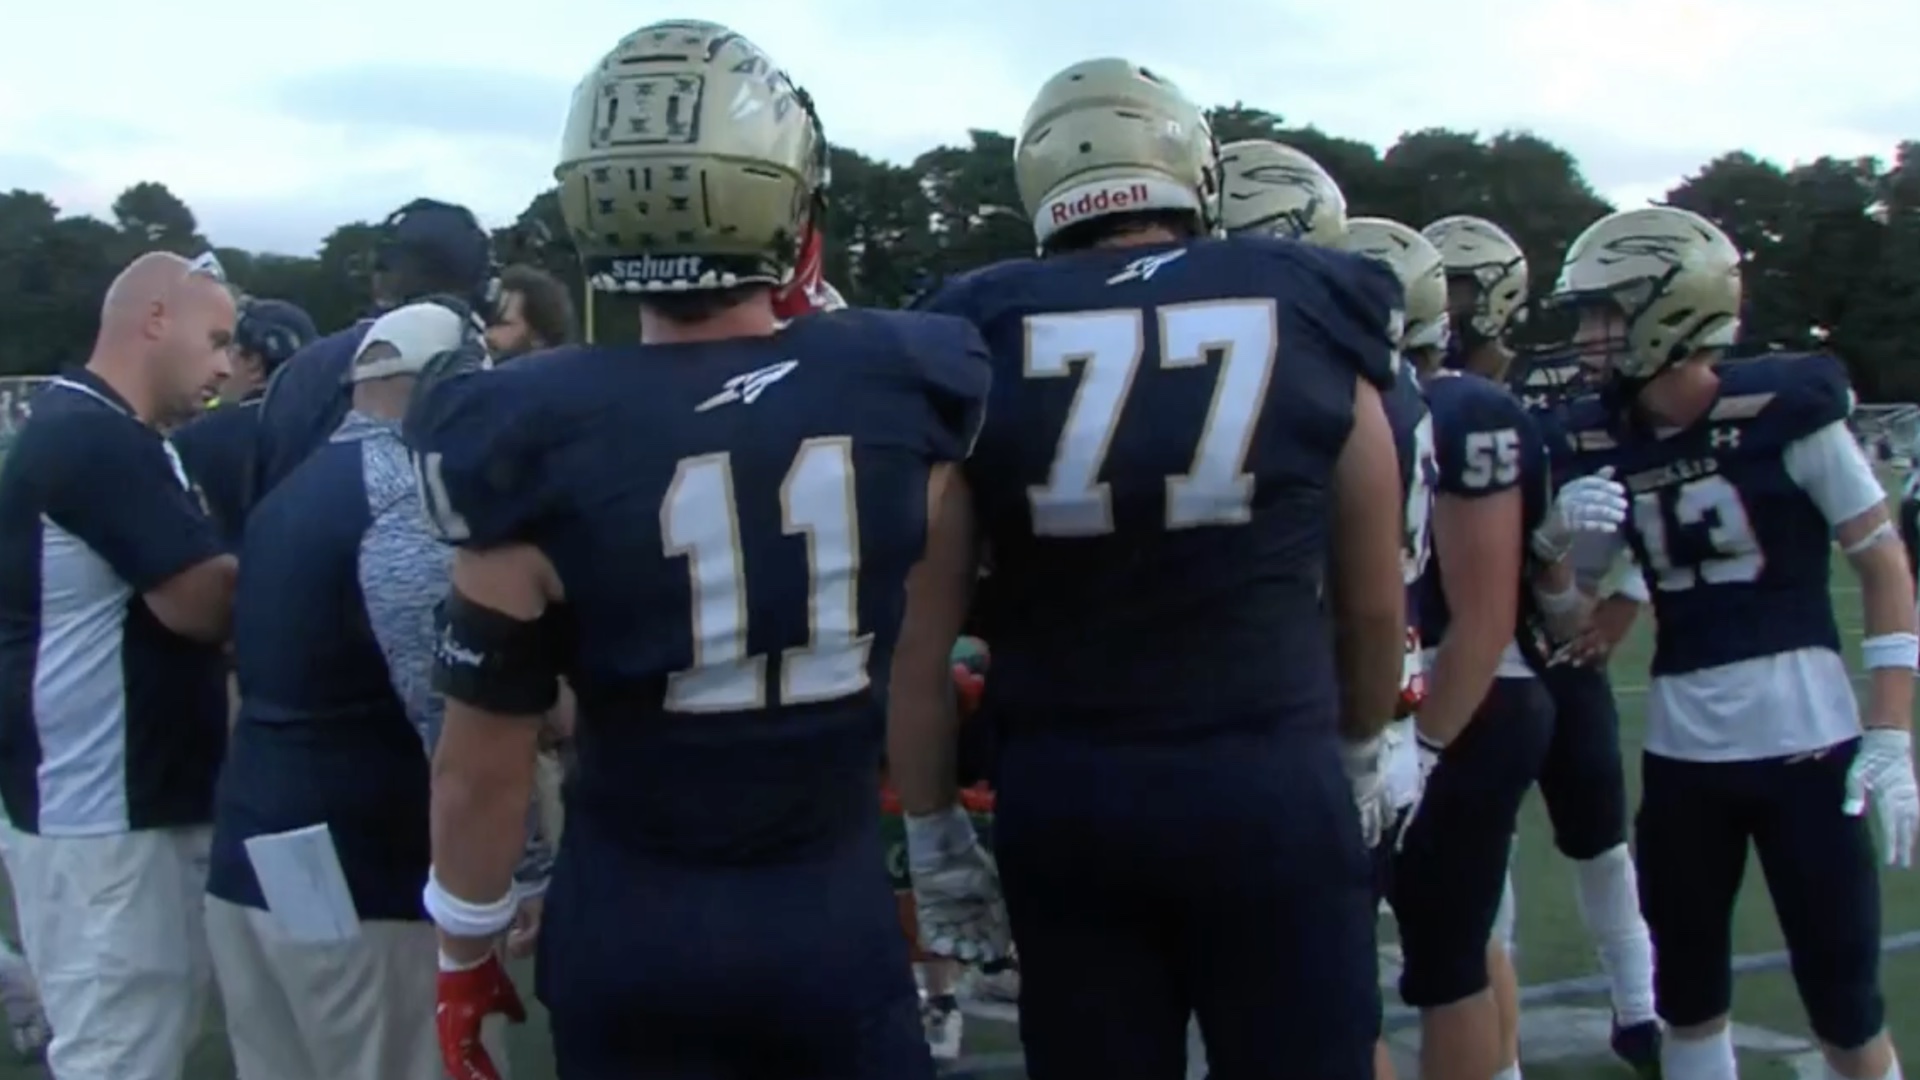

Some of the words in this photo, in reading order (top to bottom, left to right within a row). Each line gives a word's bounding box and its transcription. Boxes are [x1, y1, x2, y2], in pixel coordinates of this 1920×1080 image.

[627, 167, 652, 191] 11
[1050, 184, 1149, 225] Riddell
[1022, 298, 1278, 538] 77
[1461, 428, 1520, 488] 55
[660, 435, 875, 714] 11
[1632, 474, 1766, 592] 13
